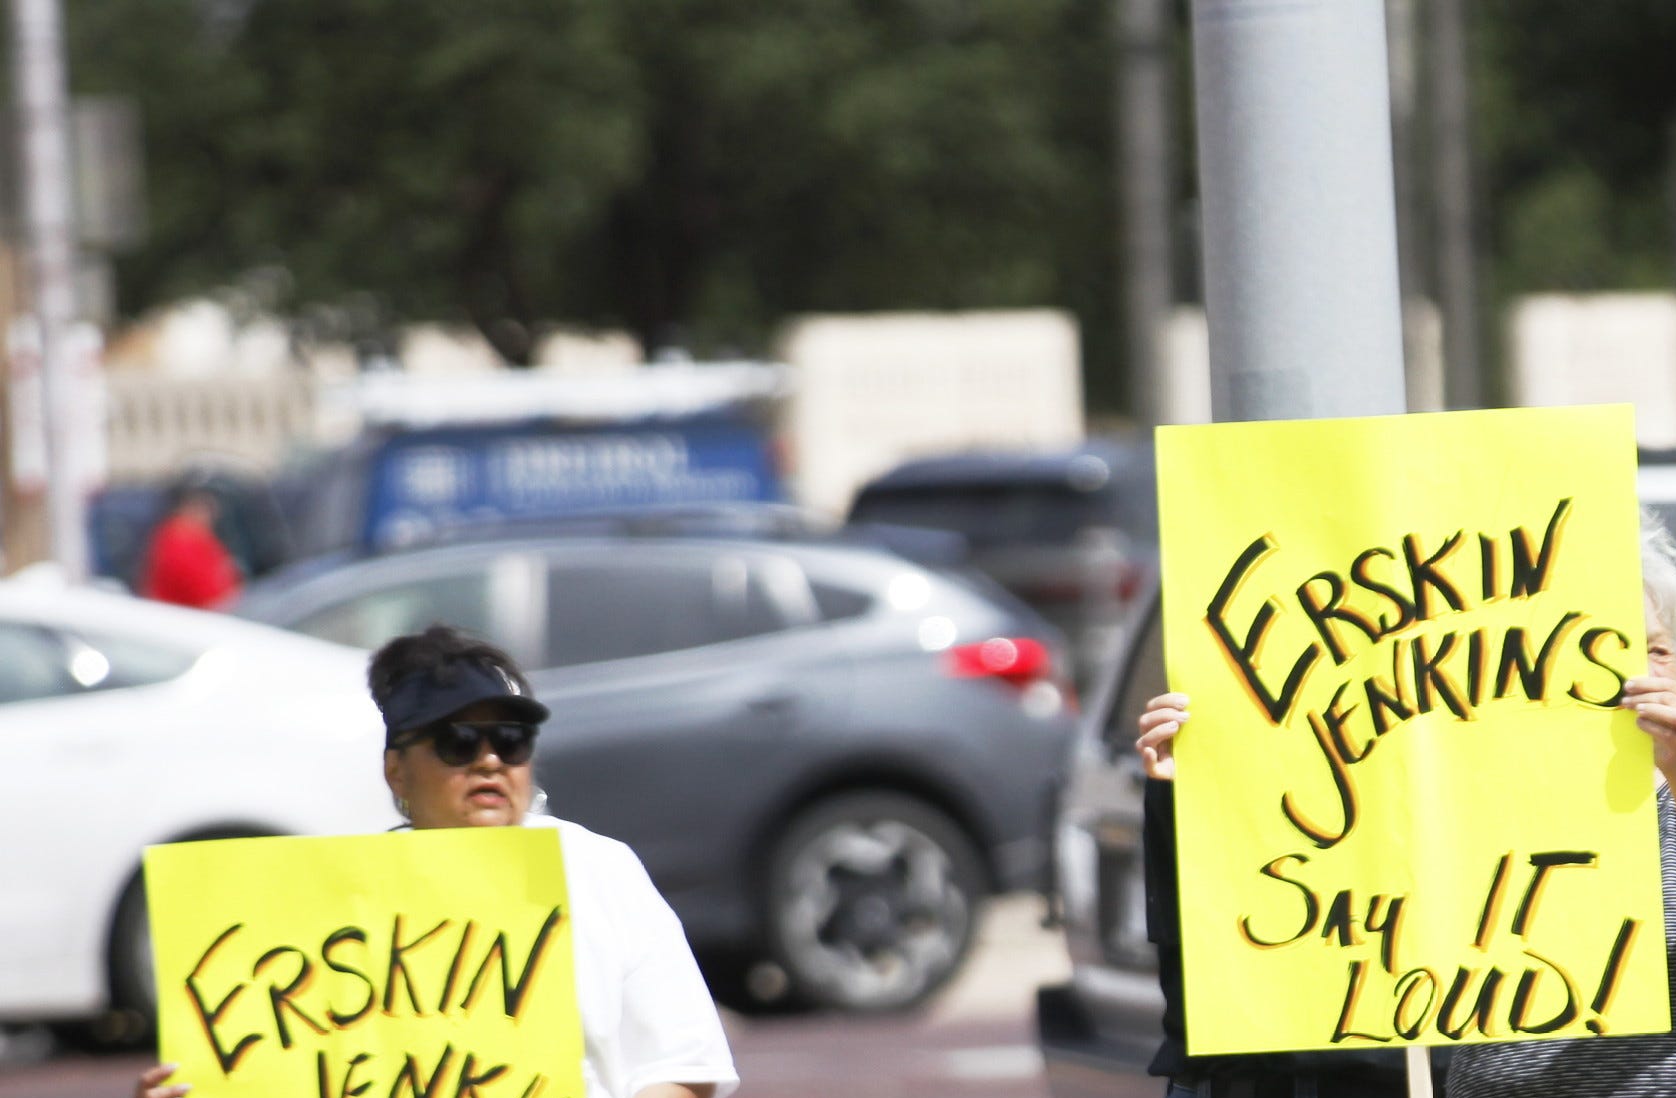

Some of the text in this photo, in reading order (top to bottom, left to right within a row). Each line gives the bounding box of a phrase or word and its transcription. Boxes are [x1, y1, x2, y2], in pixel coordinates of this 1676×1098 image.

[1203, 496, 1574, 728] ERSKIN
[1281, 610, 1631, 849] JENKINS
[1331, 917, 1644, 1044] LOUD!
[1474, 849, 1600, 951] IT
[184, 904, 567, 1076] ERSKIN
